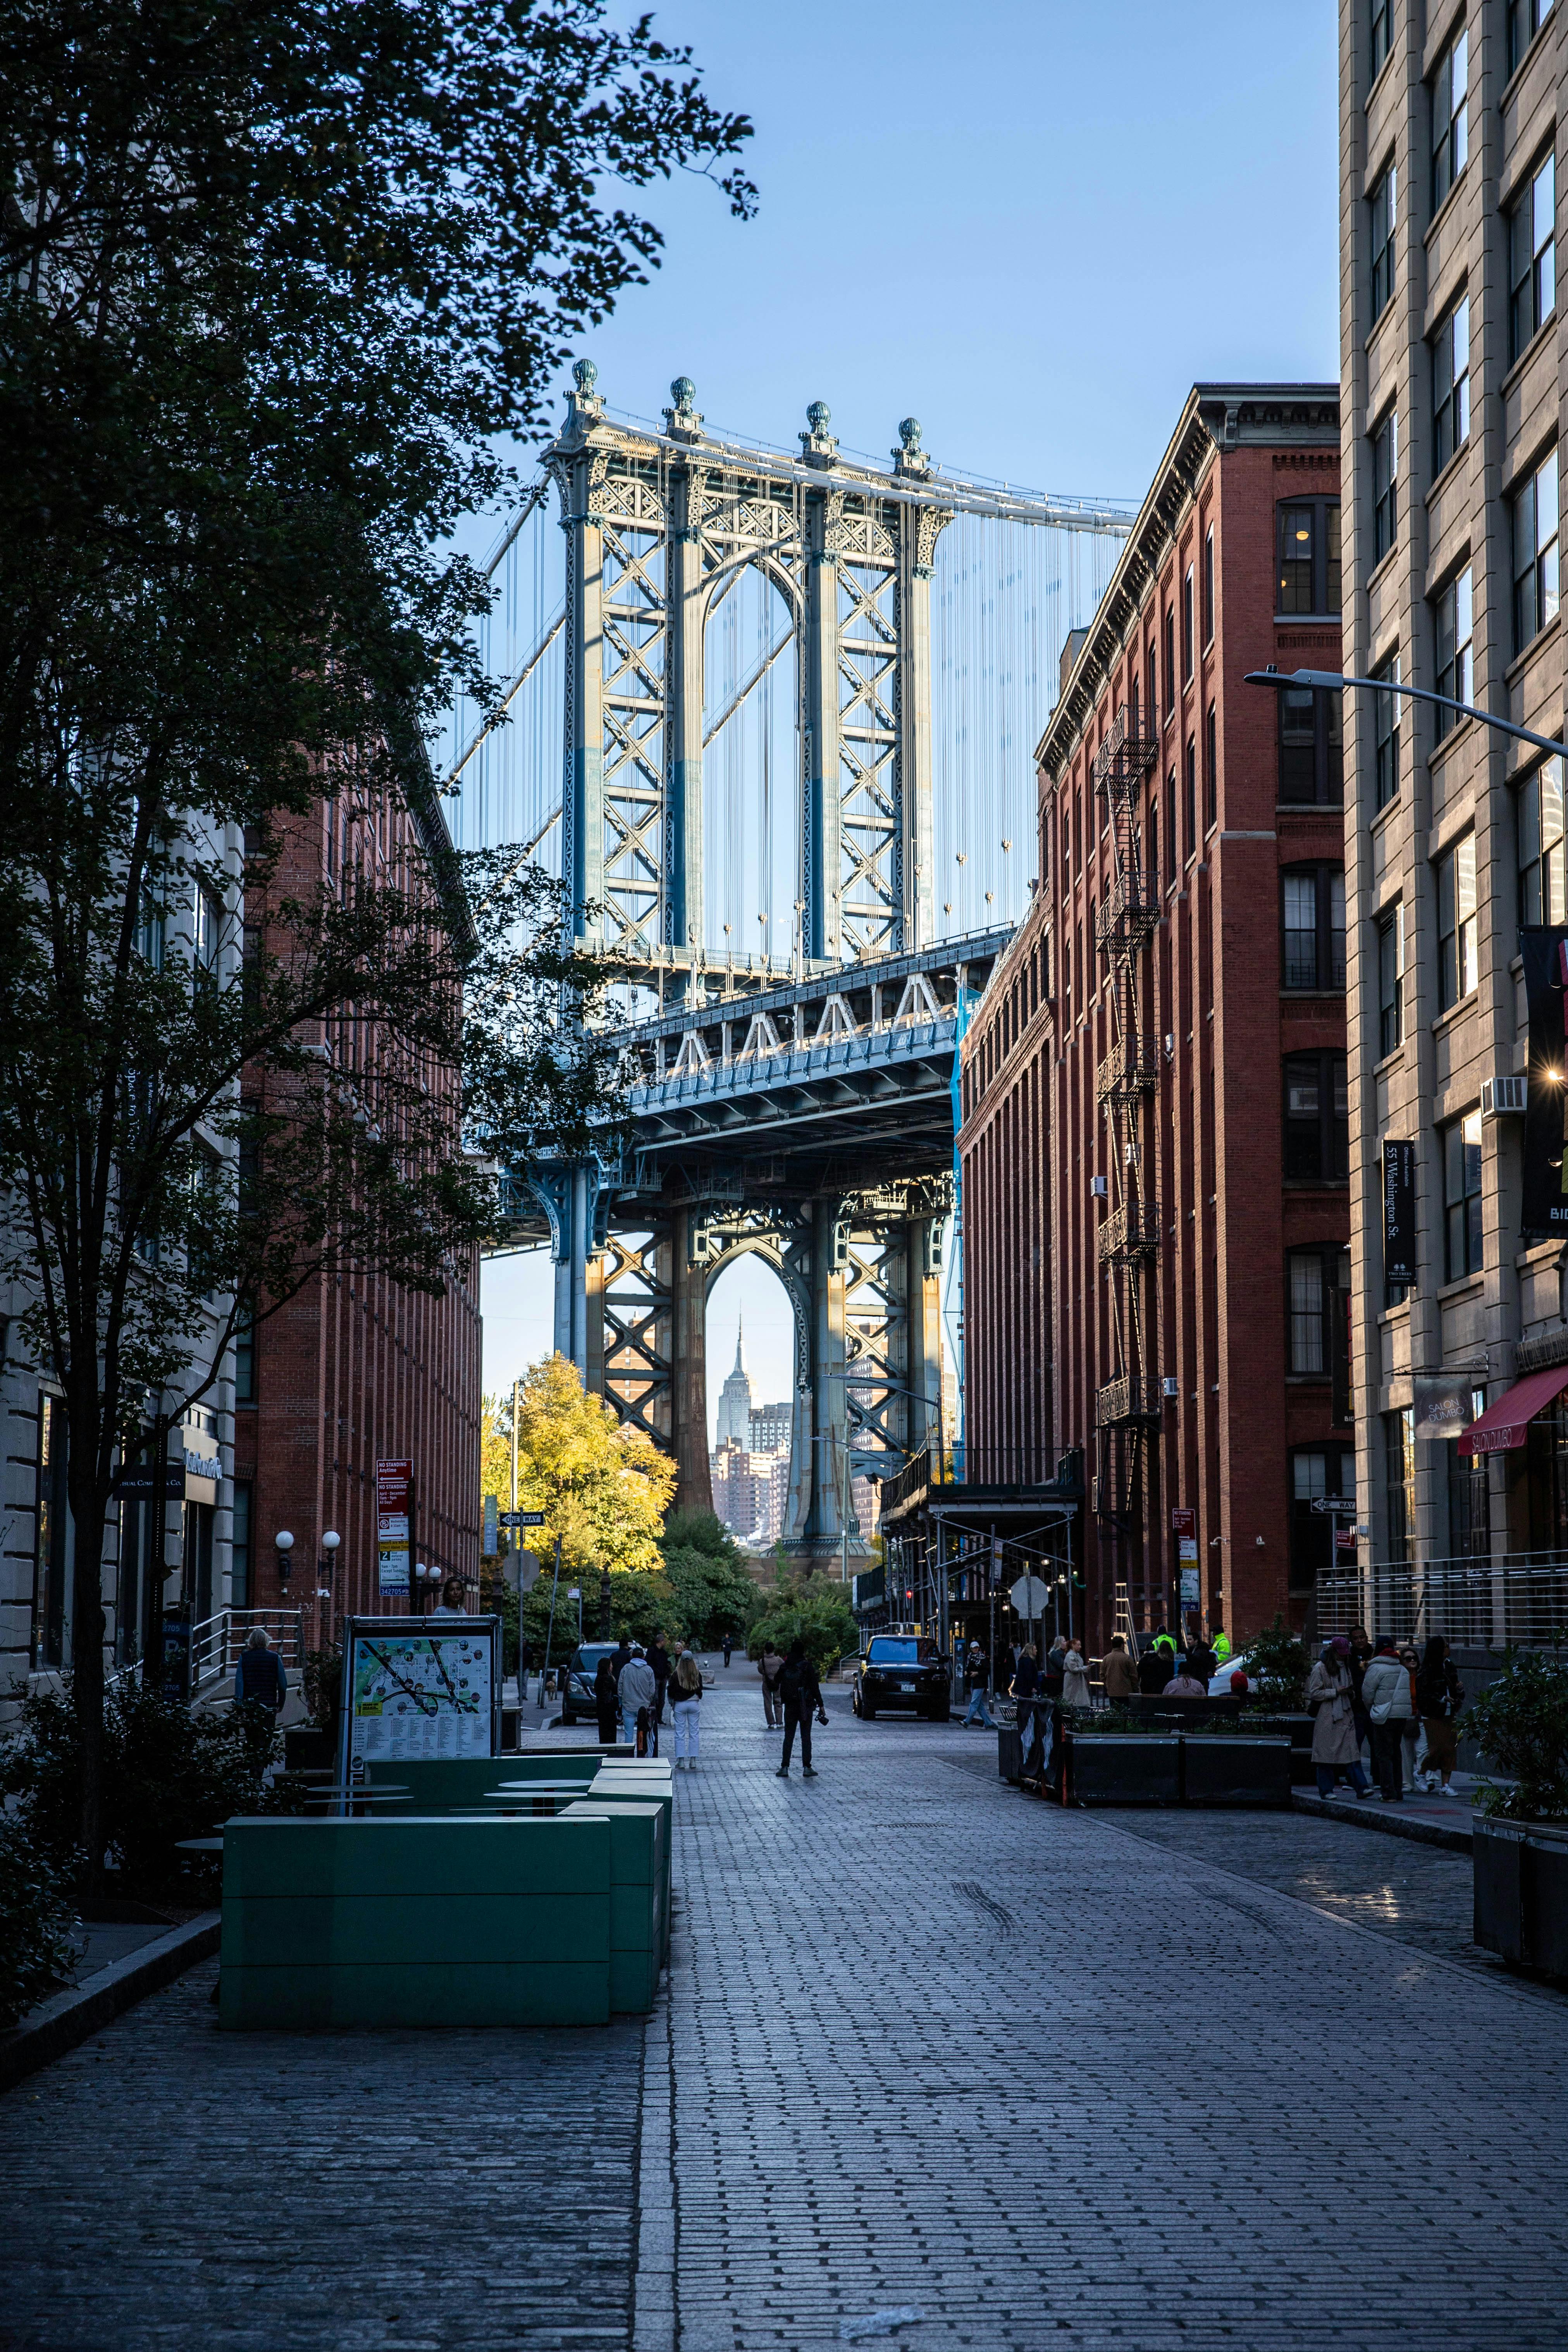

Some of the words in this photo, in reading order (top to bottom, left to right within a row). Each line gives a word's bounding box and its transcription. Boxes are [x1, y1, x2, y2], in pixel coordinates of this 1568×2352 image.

[1387, 1147, 1397, 1158] 55
[1384, 1162, 1398, 1223] Washington
[1388, 1227, 1398, 1239] St.
[1429, 1398, 1459, 1413] SALON
[1429, 1406, 1465, 1423] DUMBO
[1472, 1433, 1491, 1453] SALON
[1491, 1428, 1512, 1449] DUMBO
[382, 1552, 388, 1560] 2
